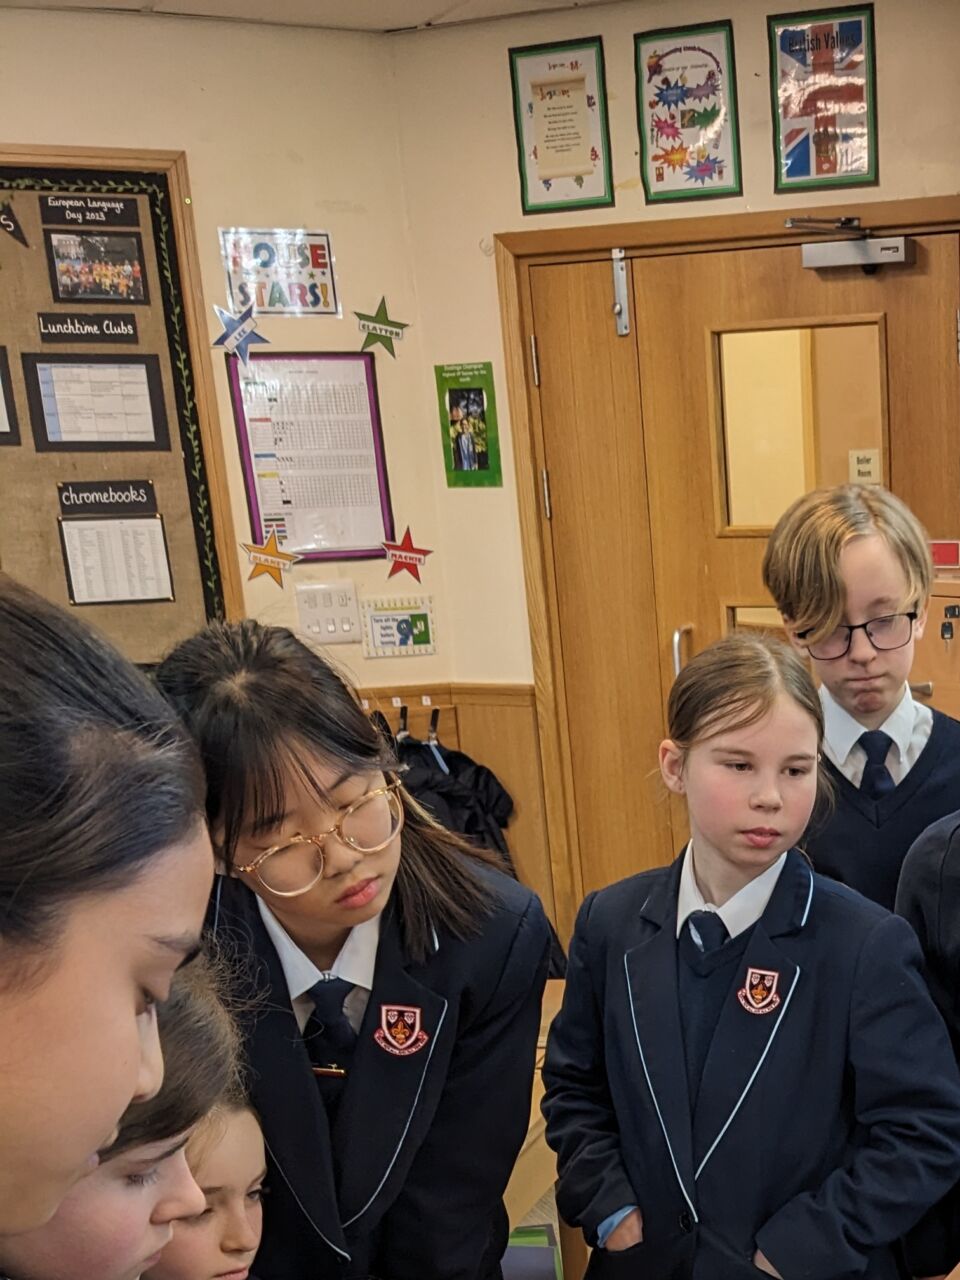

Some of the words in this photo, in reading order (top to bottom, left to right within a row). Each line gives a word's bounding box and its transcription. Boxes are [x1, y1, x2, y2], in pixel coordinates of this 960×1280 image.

[48, 197, 86, 209] European
[88, 198, 124, 214] Language
[66, 210, 82, 223] Day
[39, 317, 100, 334] Lunchtime
[103, 320, 134, 334] Clubs
[360, 322, 401, 338] CLAYTON
[233, 328, 247, 343] LEE
[856, 455, 872, 466] Boiler
[857, 468, 872, 478] Room
[62, 485, 147, 505] chromebooks
[390, 553, 423, 565] MACKIE
